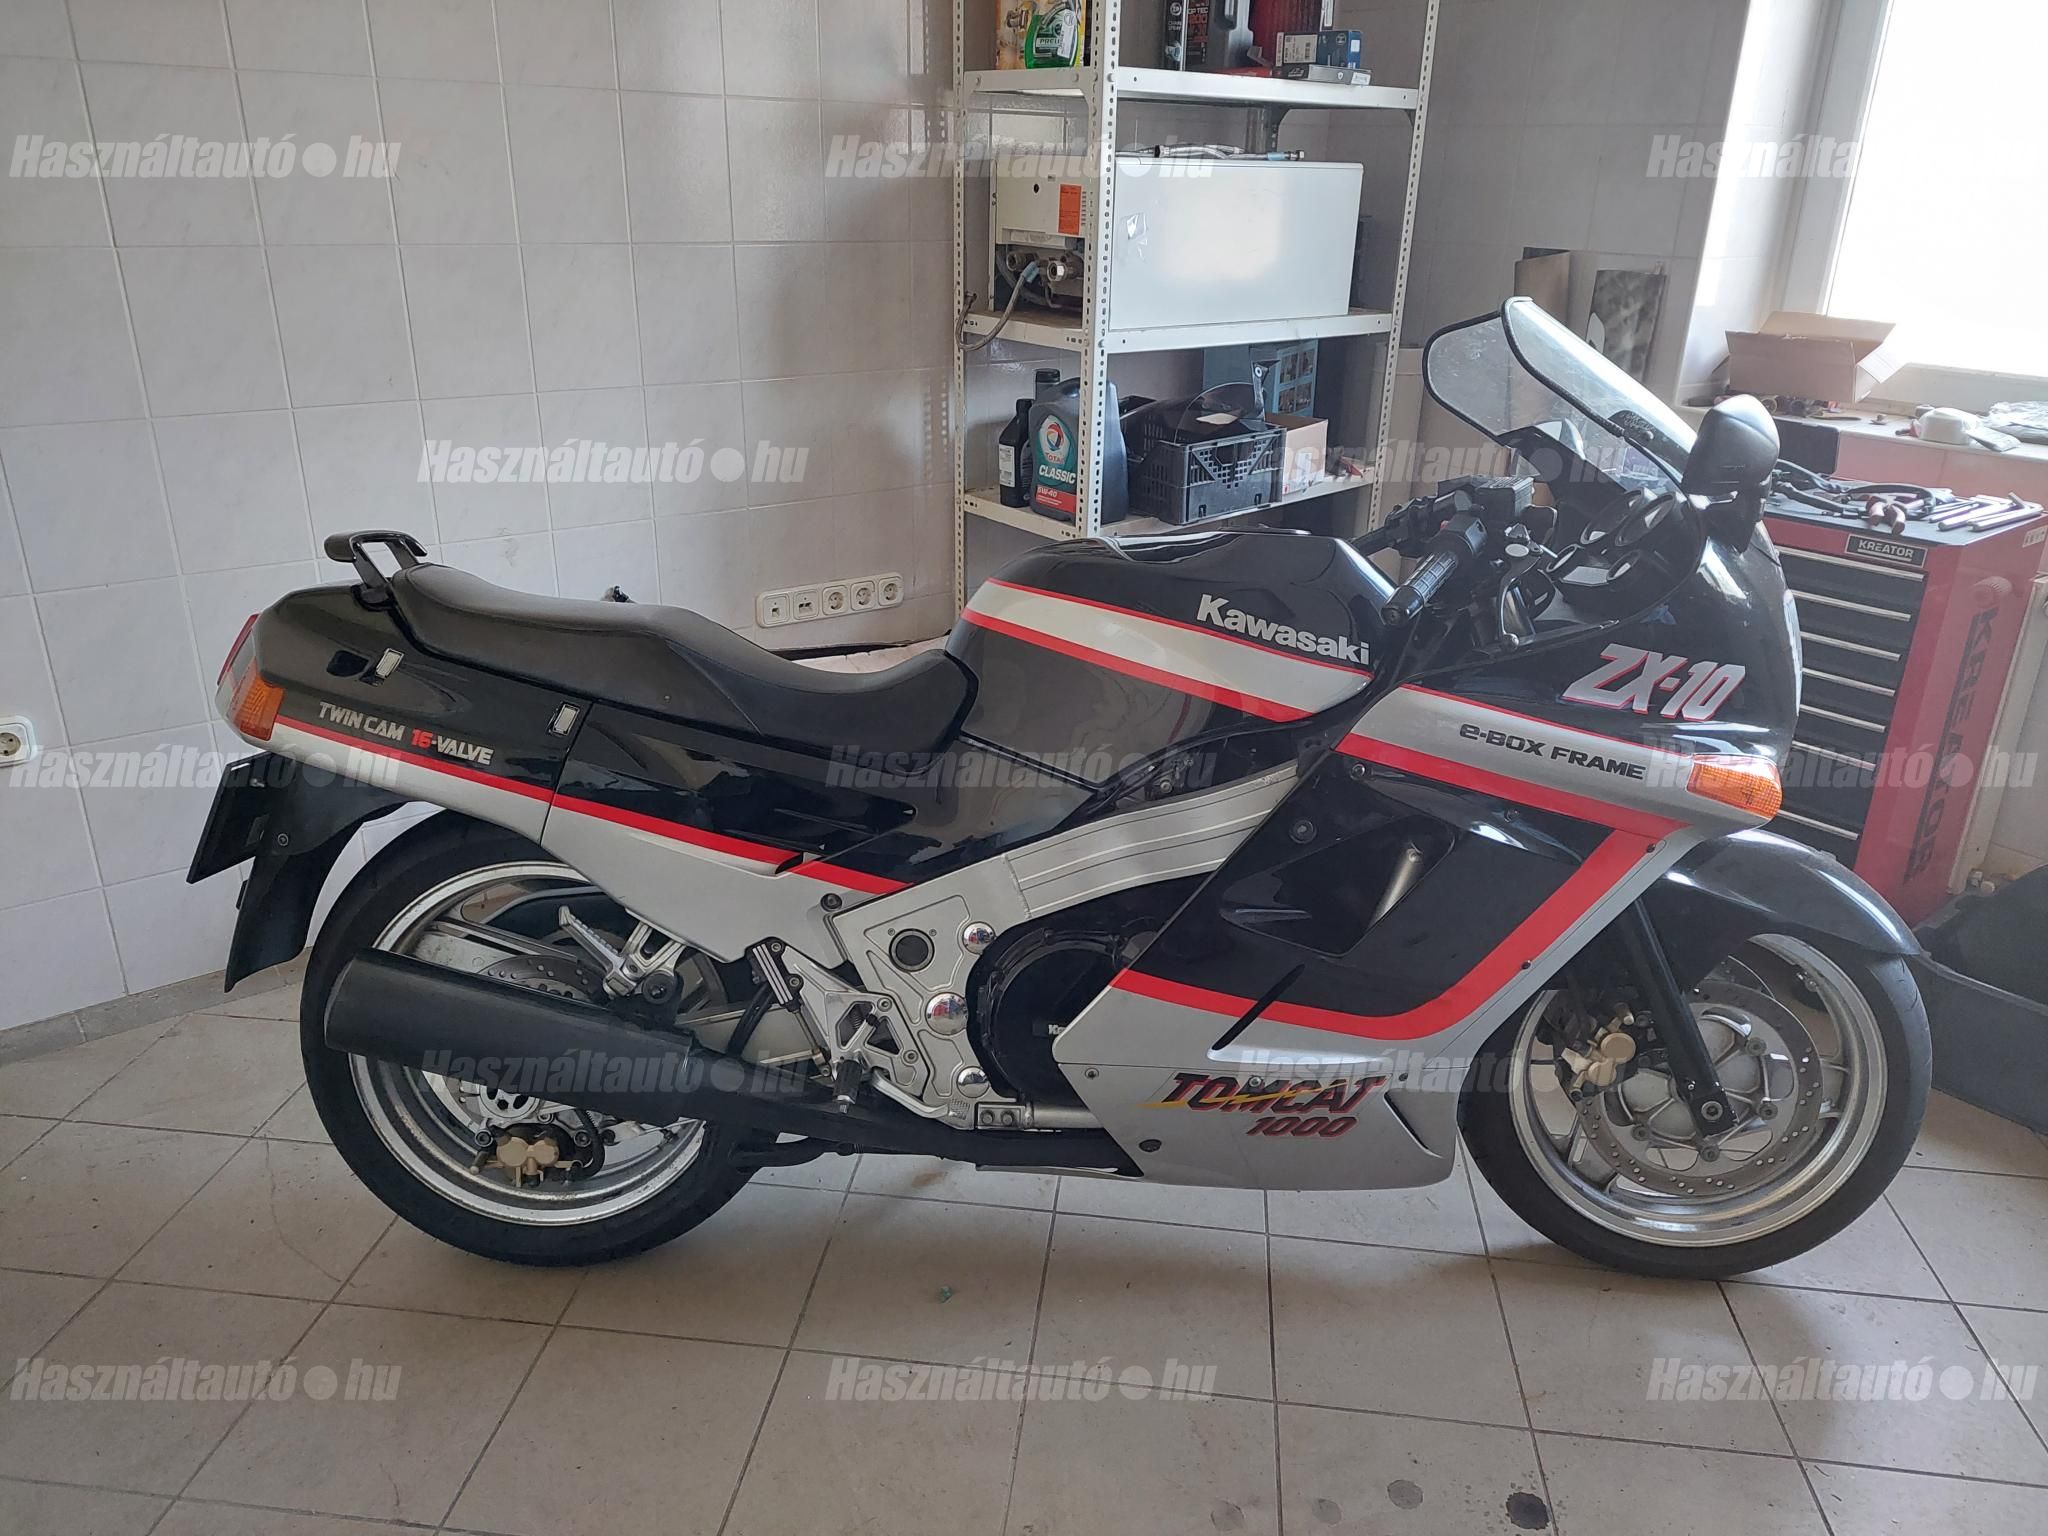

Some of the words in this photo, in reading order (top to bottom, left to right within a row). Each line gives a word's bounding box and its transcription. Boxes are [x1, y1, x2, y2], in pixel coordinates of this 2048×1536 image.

[1038, 464, 1077, 485] CLASSIC
[1857, 539, 1915, 559] KREATOR
[1196, 593, 1370, 666] Kawasaki
[1560, 643, 1746, 722] ZX-10
[319, 701, 364, 730] TWIN
[363, 716, 406, 742] CAM
[1550, 746, 1647, 780] FRAME
[1161, 1072, 1388, 1114] TOMCAT
[1245, 1116, 1359, 1138] 1000
